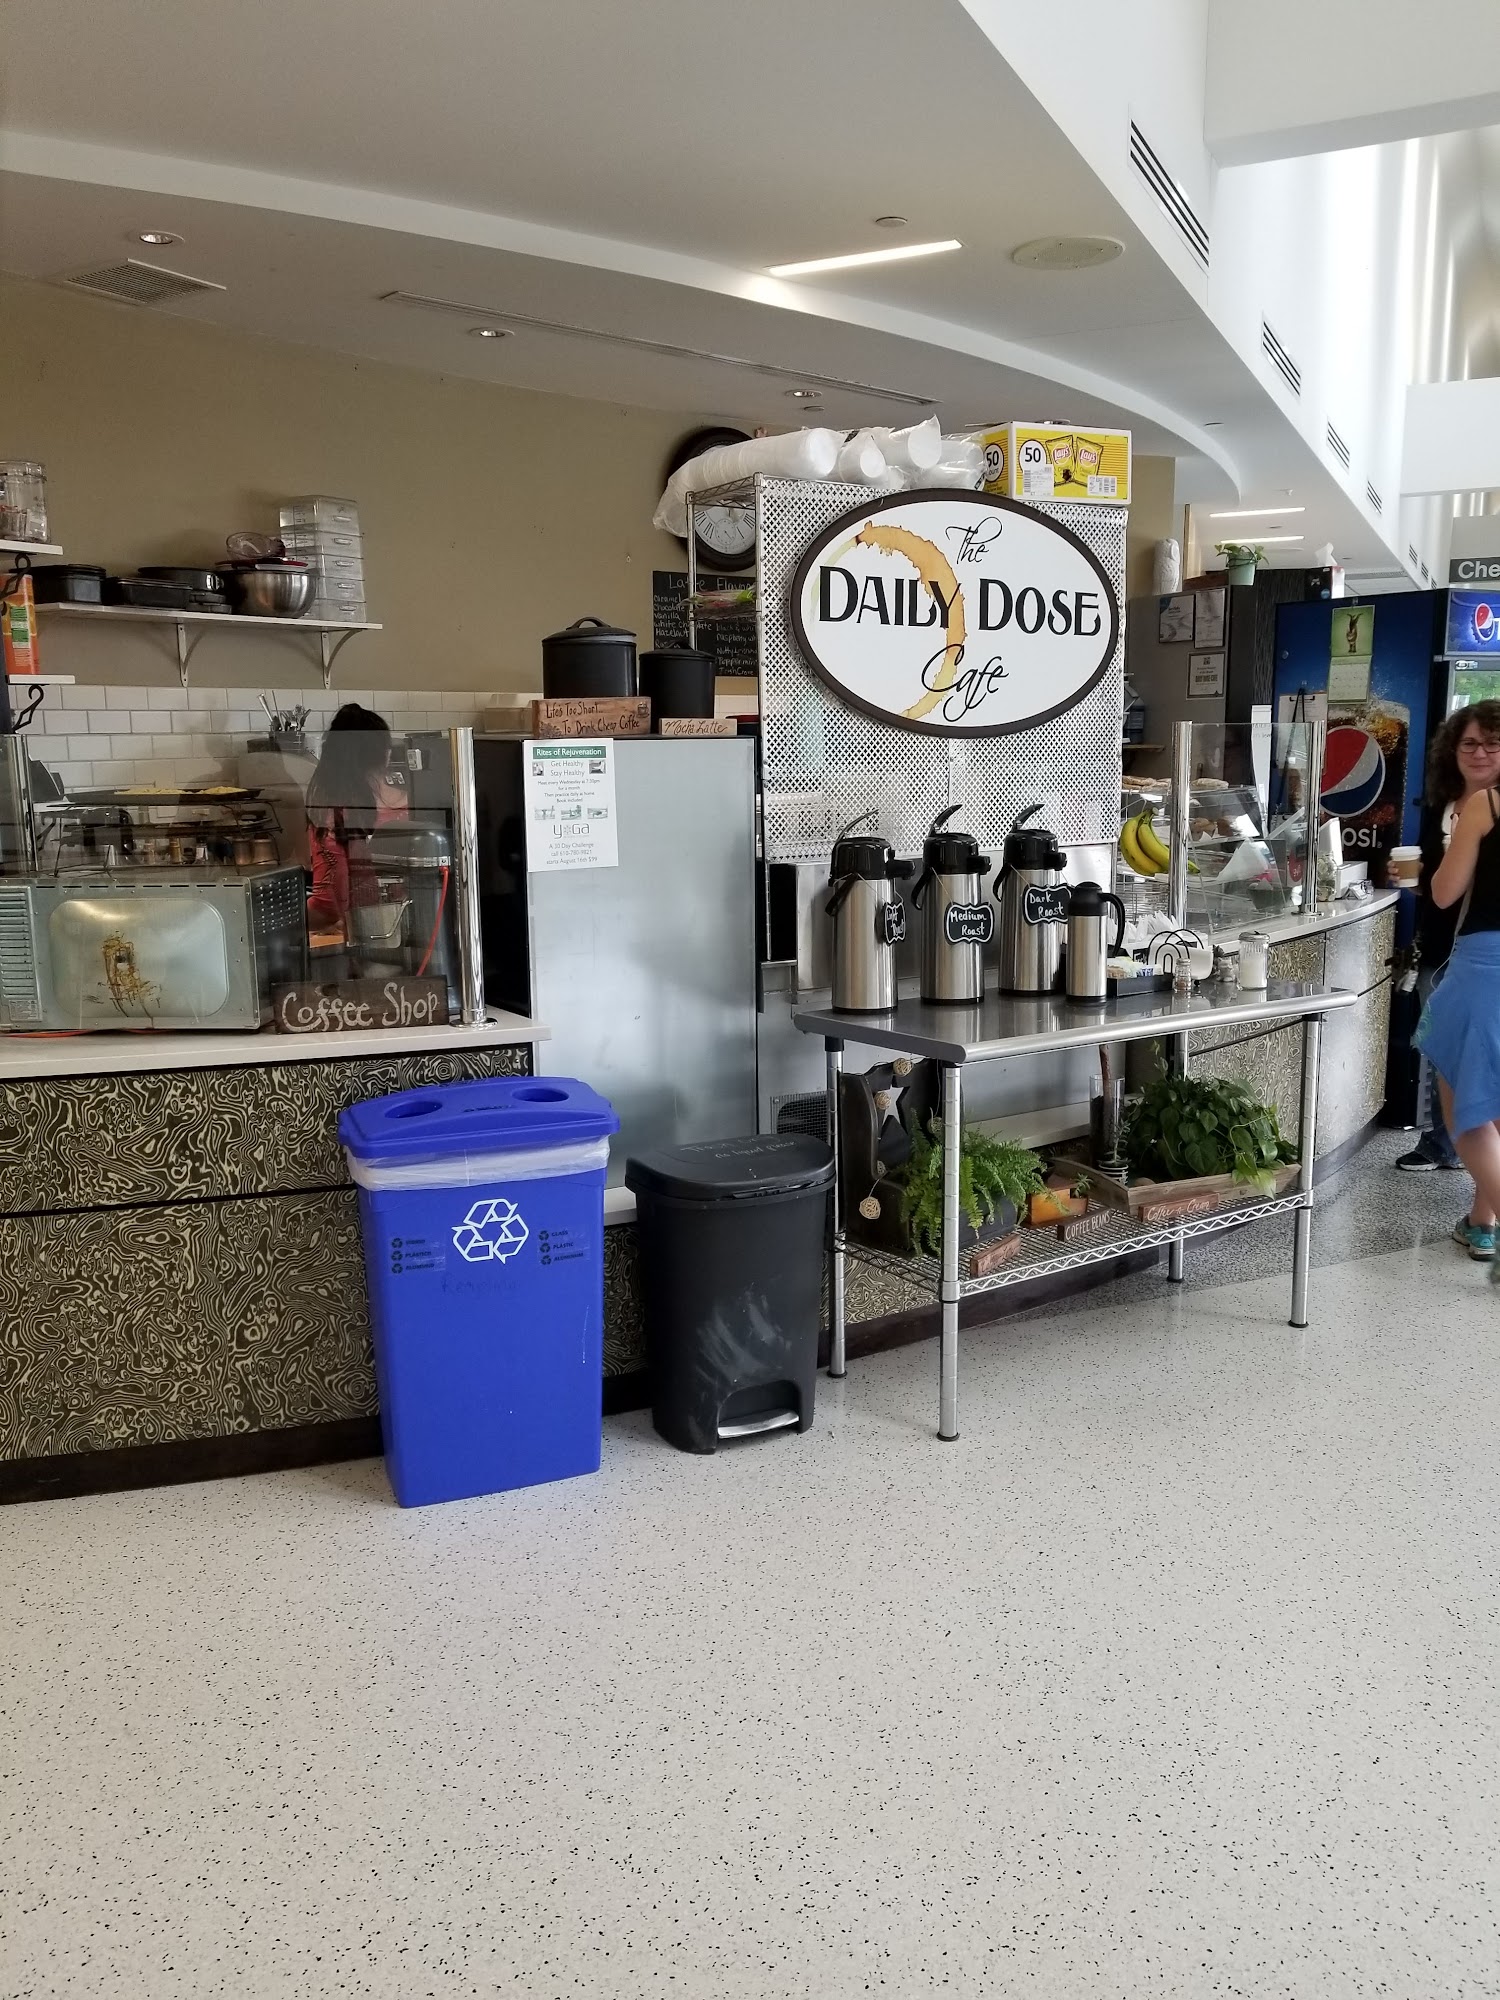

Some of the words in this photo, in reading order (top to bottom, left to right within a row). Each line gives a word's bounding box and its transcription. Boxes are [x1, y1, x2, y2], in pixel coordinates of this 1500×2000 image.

[986, 451, 999, 467] 50
[1025, 447, 1041, 463] 50
[1054, 446, 1069, 460] Lay's
[1080, 449, 1096, 460] Lay's
[945, 516, 1002, 565] The
[818, 565, 961, 629] DAILY
[978, 578, 1102, 637] DOSE
[921, 644, 1009, 722] Cafe
[565, 702, 577, 716] Too
[562, 720, 571, 735] To
[576, 720, 597, 735] Drink
[598, 717, 617, 732] Cheap
[619, 714, 640, 731] Coffee
[665, 720, 694, 736] Mocha
[696, 720, 728, 735] Latte
[536, 748, 552, 756] Rites
[553, 748, 560, 756] of
[561, 747, 602, 757] Rejuvenation
[562, 760, 584, 768] Healthy
[551, 770, 562, 778] Stay
[563, 769, 585, 777] Healthy
[1029, 892, 1054, 904] Dark
[950, 910, 987, 923] Medium
[1038, 904, 1065, 918] Roast
[961, 924, 985, 936] Roast
[282, 991, 374, 1033] Coffee
[382, 982, 440, 1026] Shop
[1065, 1219, 1090, 1241] COFFEE
[1091, 1212, 1111, 1231] BEANS
